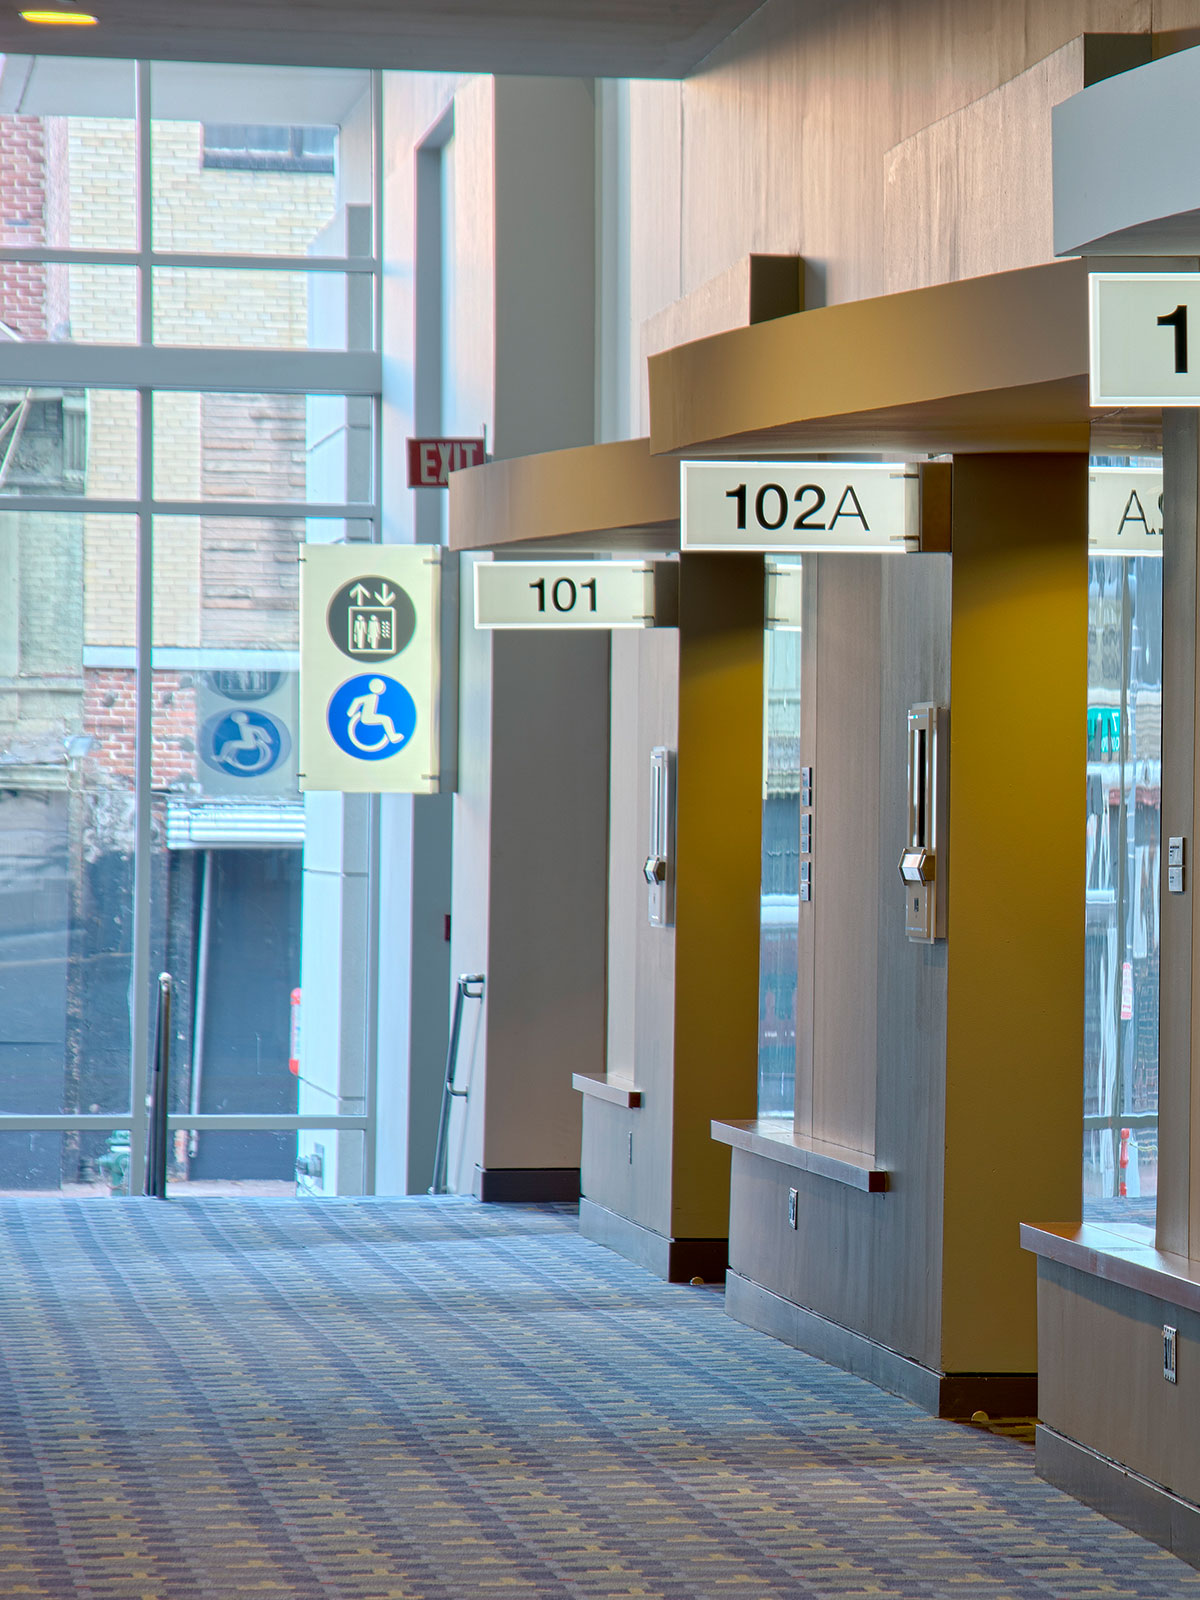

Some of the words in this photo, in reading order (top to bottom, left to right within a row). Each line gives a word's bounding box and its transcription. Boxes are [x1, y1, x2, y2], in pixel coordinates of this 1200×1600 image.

[420, 443, 477, 483] EXIT
[725, 483, 870, 531] 102A
[528, 577, 597, 612] 101
